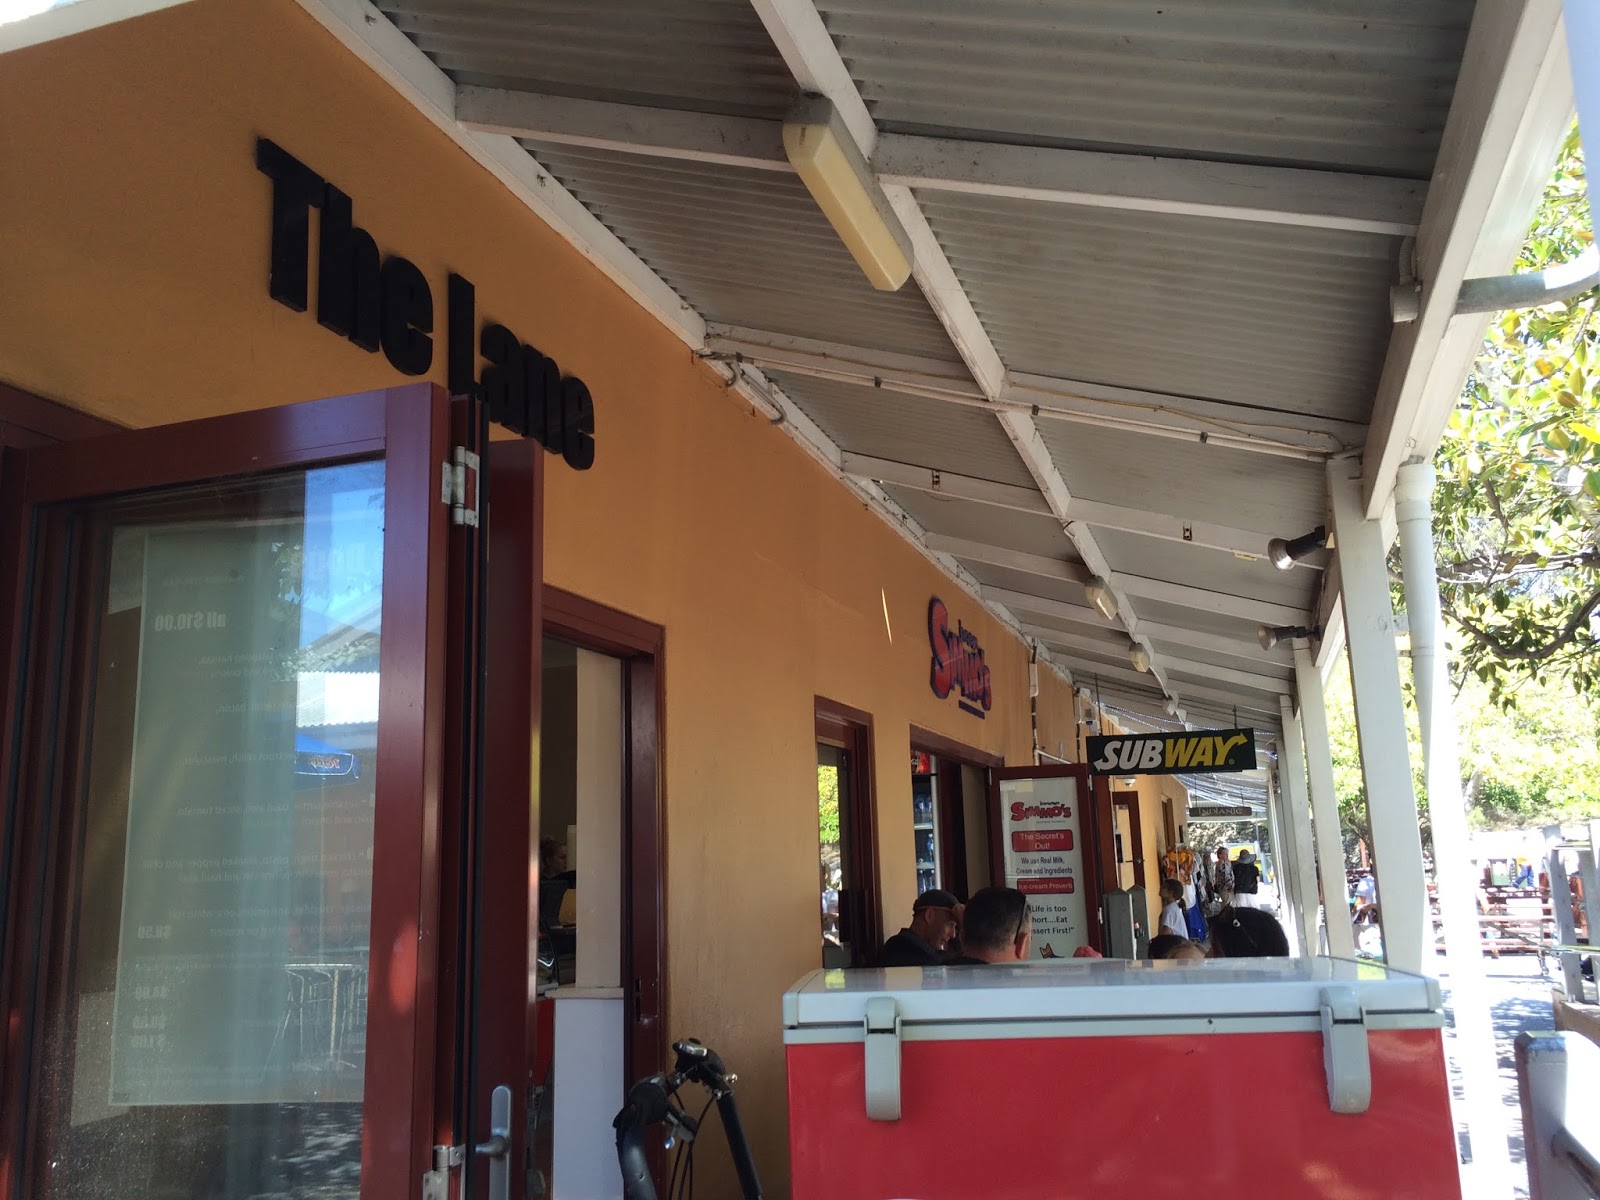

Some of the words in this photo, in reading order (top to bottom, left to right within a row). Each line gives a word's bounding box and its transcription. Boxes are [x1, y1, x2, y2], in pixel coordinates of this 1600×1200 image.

[256, 138, 433, 376] The
[449, 272, 595, 470] Lane
[1093, 733, 1248, 771] SUBWAY
[1035, 832, 1064, 840] Secret's
[1044, 866, 1073, 876] Ingredients
